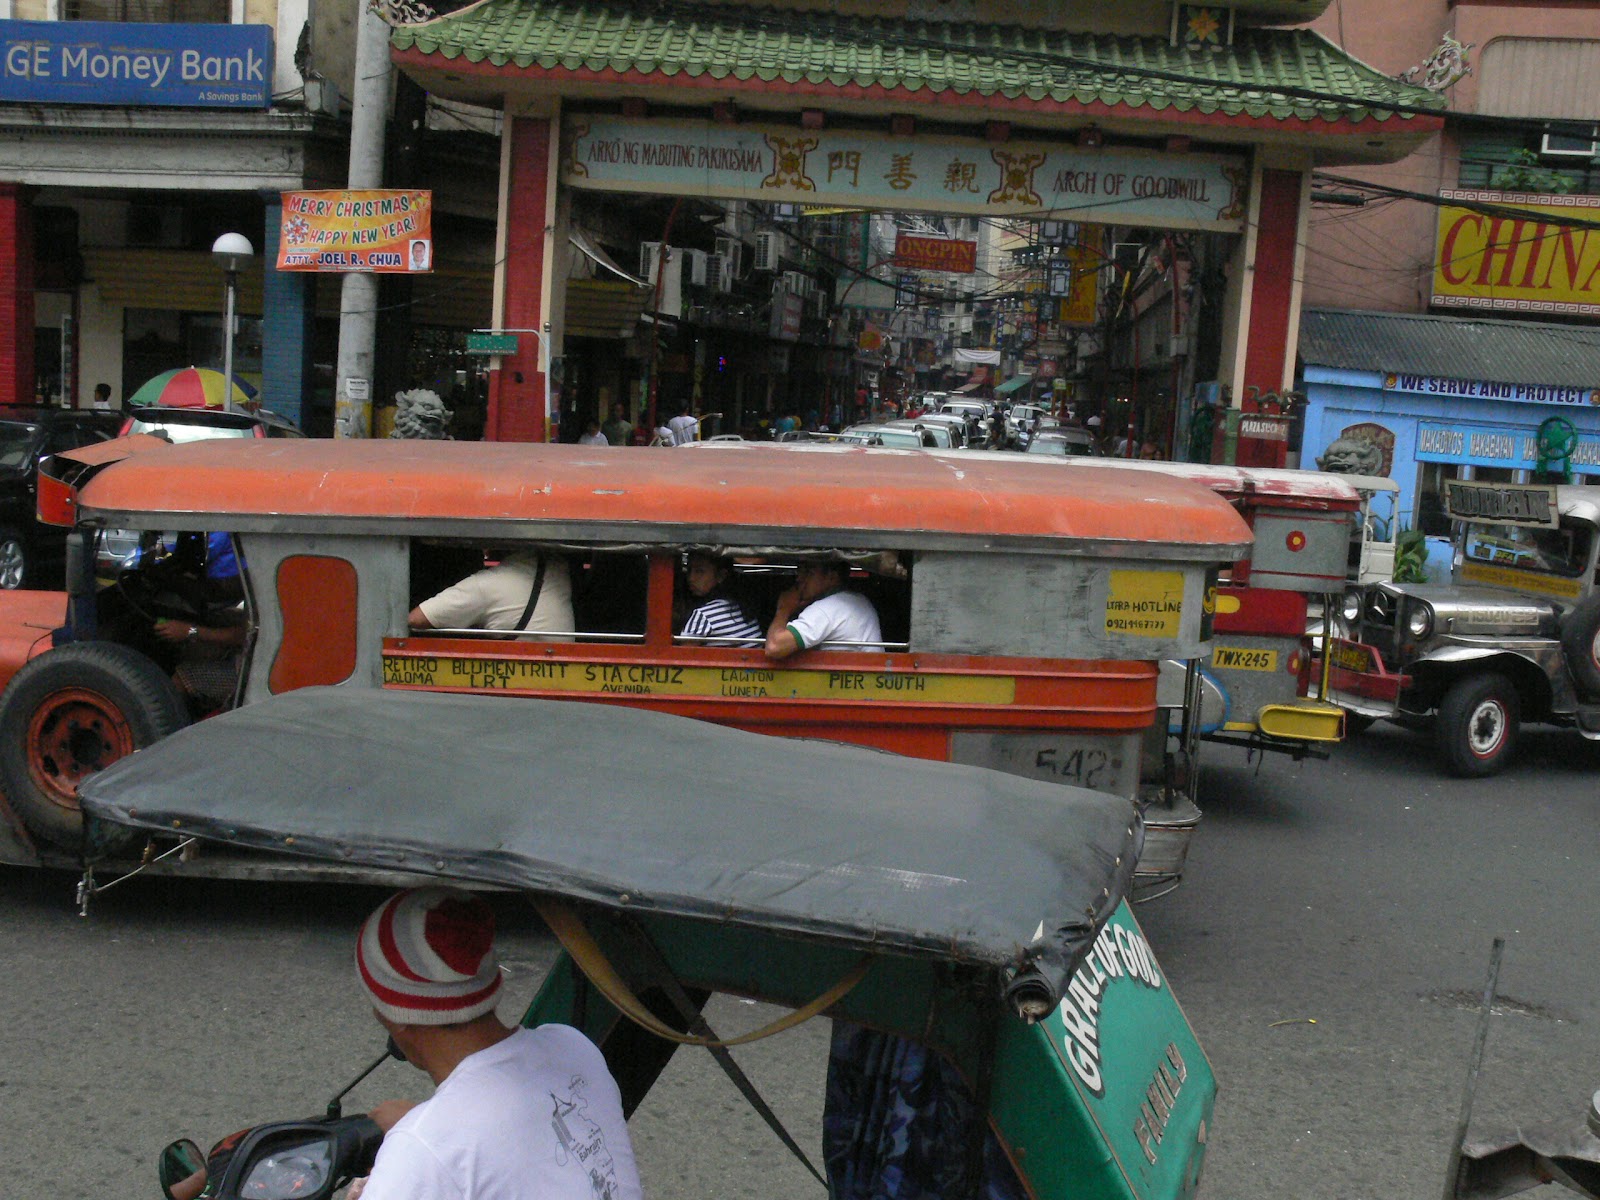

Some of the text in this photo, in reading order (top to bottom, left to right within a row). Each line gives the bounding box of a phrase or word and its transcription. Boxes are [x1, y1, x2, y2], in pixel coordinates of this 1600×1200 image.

[7, 45, 264, 87] GE Money Bank
[199, 92, 263, 103] A Savings Bank
[623, 142, 639, 165] NG
[641, 143, 695, 168] MABUTING
[1053, 170, 1210, 202] ARCH OF GOODWILL
[289, 195, 409, 217] MERRY CHRISTMAS
[309, 216, 416, 245] HAPPY NEW YEAR!
[285, 252, 401, 265] ATTY. JOEL R. CHUA
[1400, 375, 1587, 404] WE SERVE AND PROTECT
[1469, 434, 1516, 459] MAKABAYAN
[1132, 601, 1182, 613] HOTLINE
[383, 657, 438, 673] RETIRO
[452, 657, 568, 679] BLUMENTRITT
[627, 665, 684, 685] CRUZ
[721, 669, 775, 683] LAWTON
[829, 673, 865, 690] PIER
[875, 675, 925, 692] SOUTH
[600, 684, 651, 694] AVENIDA
[721, 685, 768, 697] LUNETA
[579, 1137, 602, 1163] Bahrain
